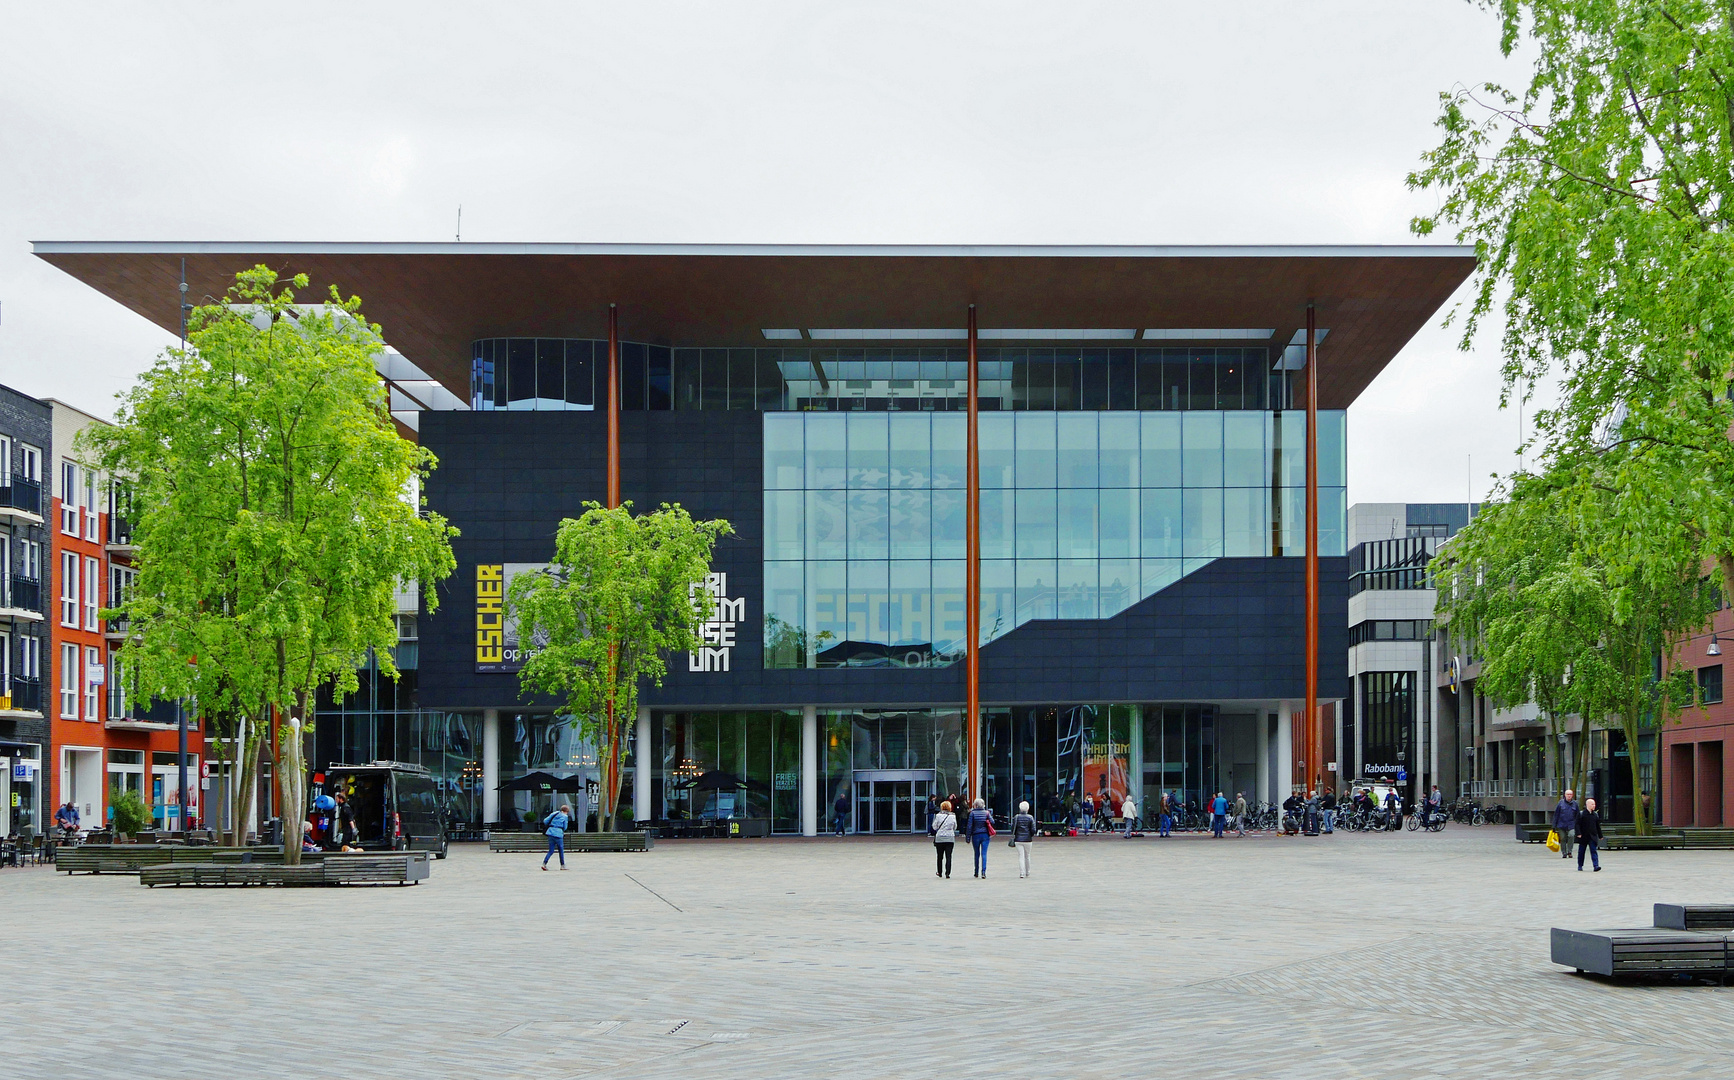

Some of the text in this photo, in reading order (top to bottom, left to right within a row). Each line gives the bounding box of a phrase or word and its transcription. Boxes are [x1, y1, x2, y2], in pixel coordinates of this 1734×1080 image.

[477, 565, 502, 662] ESCHER
[689, 647, 729, 671] UM
[1364, 763, 1405, 773] Rabobank
